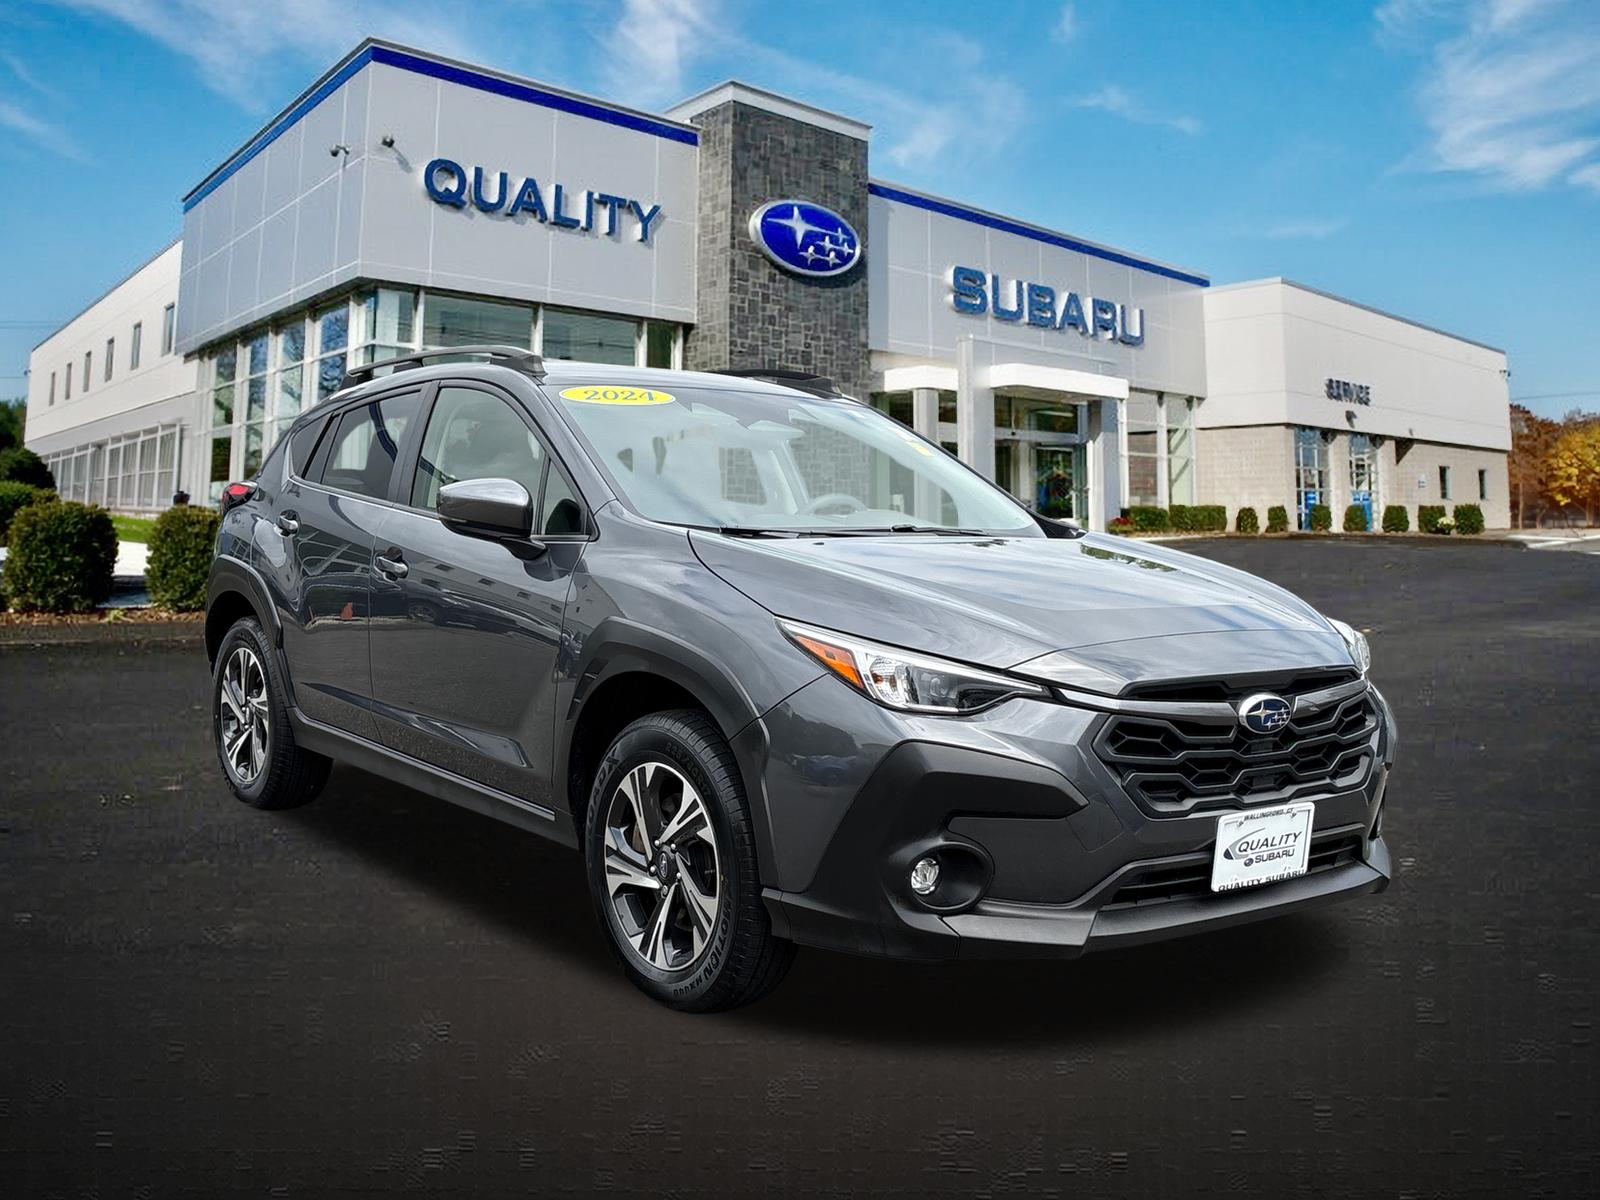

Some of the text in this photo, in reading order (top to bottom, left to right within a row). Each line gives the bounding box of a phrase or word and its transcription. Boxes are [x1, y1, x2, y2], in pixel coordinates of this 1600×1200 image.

[424, 158, 661, 242] QUALITY
[951, 265, 1145, 346] SUBARU
[583, 390, 656, 401] 2024
[1325, 378, 1371, 406] SERVICE
[1238, 831, 1302, 853] QUALITY
[1254, 849, 1295, 864] SUBARU
[1218, 868, 1305, 892] QUALITY SUBARU
